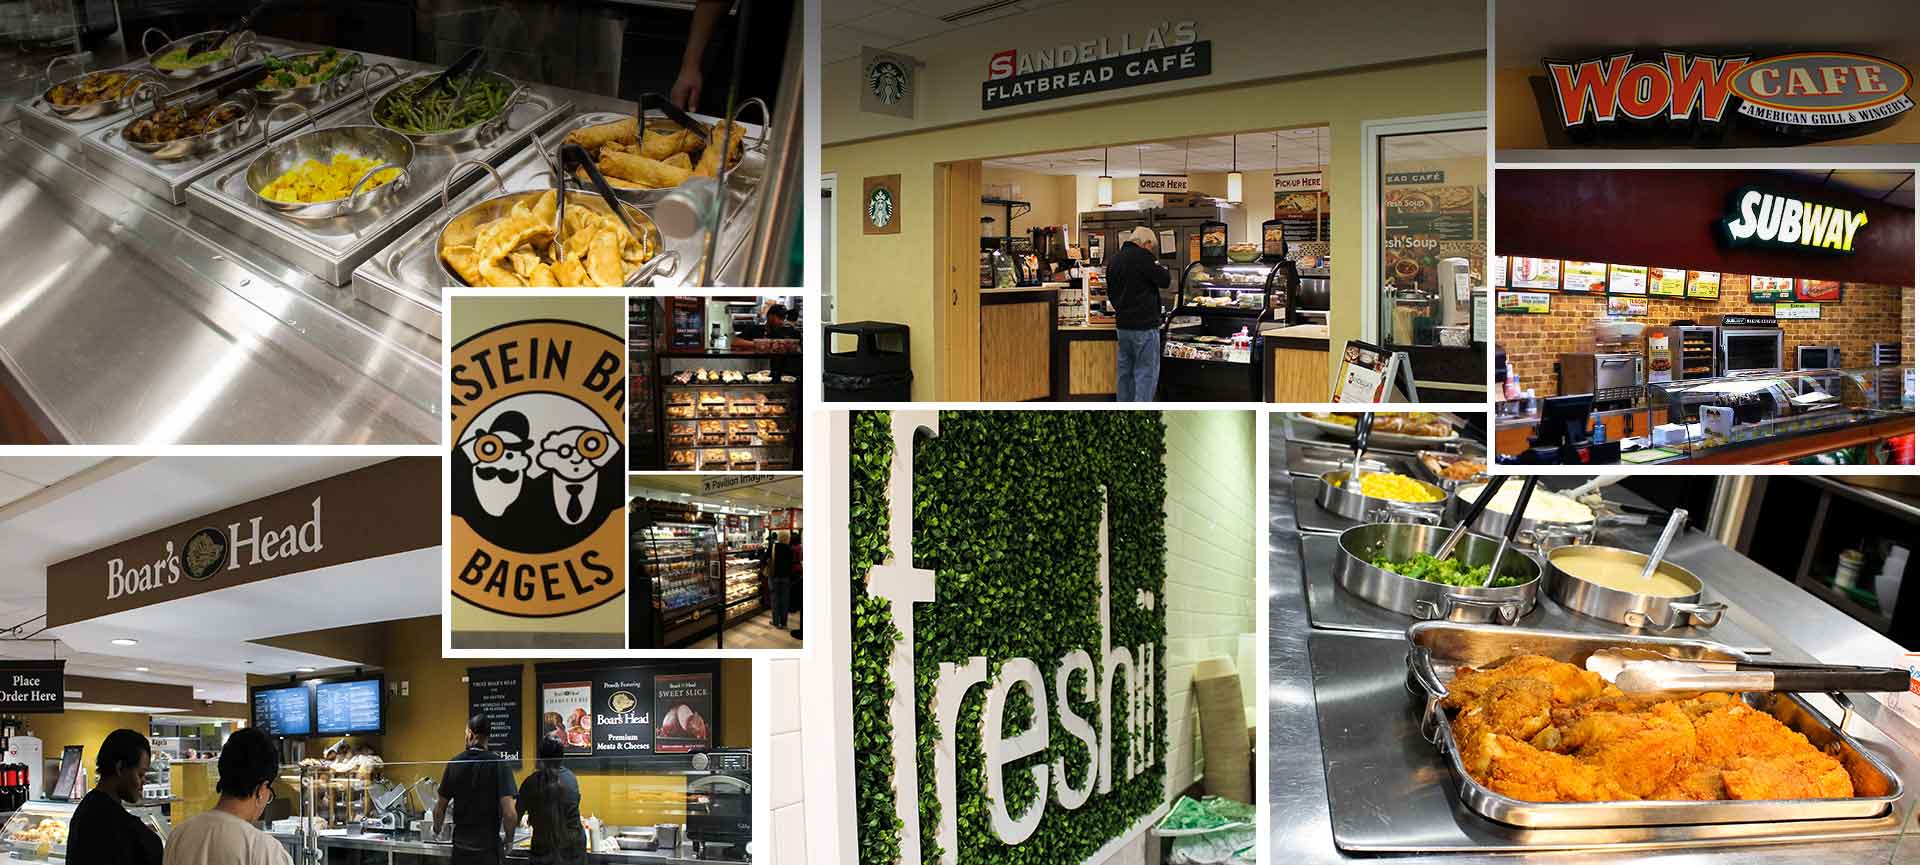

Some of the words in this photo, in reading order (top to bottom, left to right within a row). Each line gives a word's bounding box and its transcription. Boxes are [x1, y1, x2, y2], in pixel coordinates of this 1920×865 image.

[990, 20, 1198, 80] SANDELLA'S
[986, 66, 1114, 102] FLATBREAD
[1126, 47, 1196, 77] CAFÉ
[1750, 65, 1888, 97] CAFE
[1747, 105, 1807, 124] AMERICAN
[1811, 113, 1845, 124] GRILL
[1850, 112, 1857, 122] &
[1858, 101, 1907, 121] WINGERY
[1140, 176, 1166, 188] ORDER
[1166, 177, 1188, 188] HERE
[1302, 177, 1321, 187] HERE
[1404, 200, 1424, 209] Soup
[1728, 190, 1868, 251] SUBWAY
[1405, 237, 1437, 250] Soup
[106, 541, 180, 600] Boar's
[227, 496, 323, 570] Head
[458, 548, 614, 602] BAGELS
[867, 410, 1155, 865] freshii
[13, 675, 40, 687] Place
[31, 691, 57, 701] Here
[686, 688, 707, 696] SLICE
[625, 712, 649, 724] Head
[624, 742, 650, 750] Cheeses
[500, 751, 519, 761] Head
